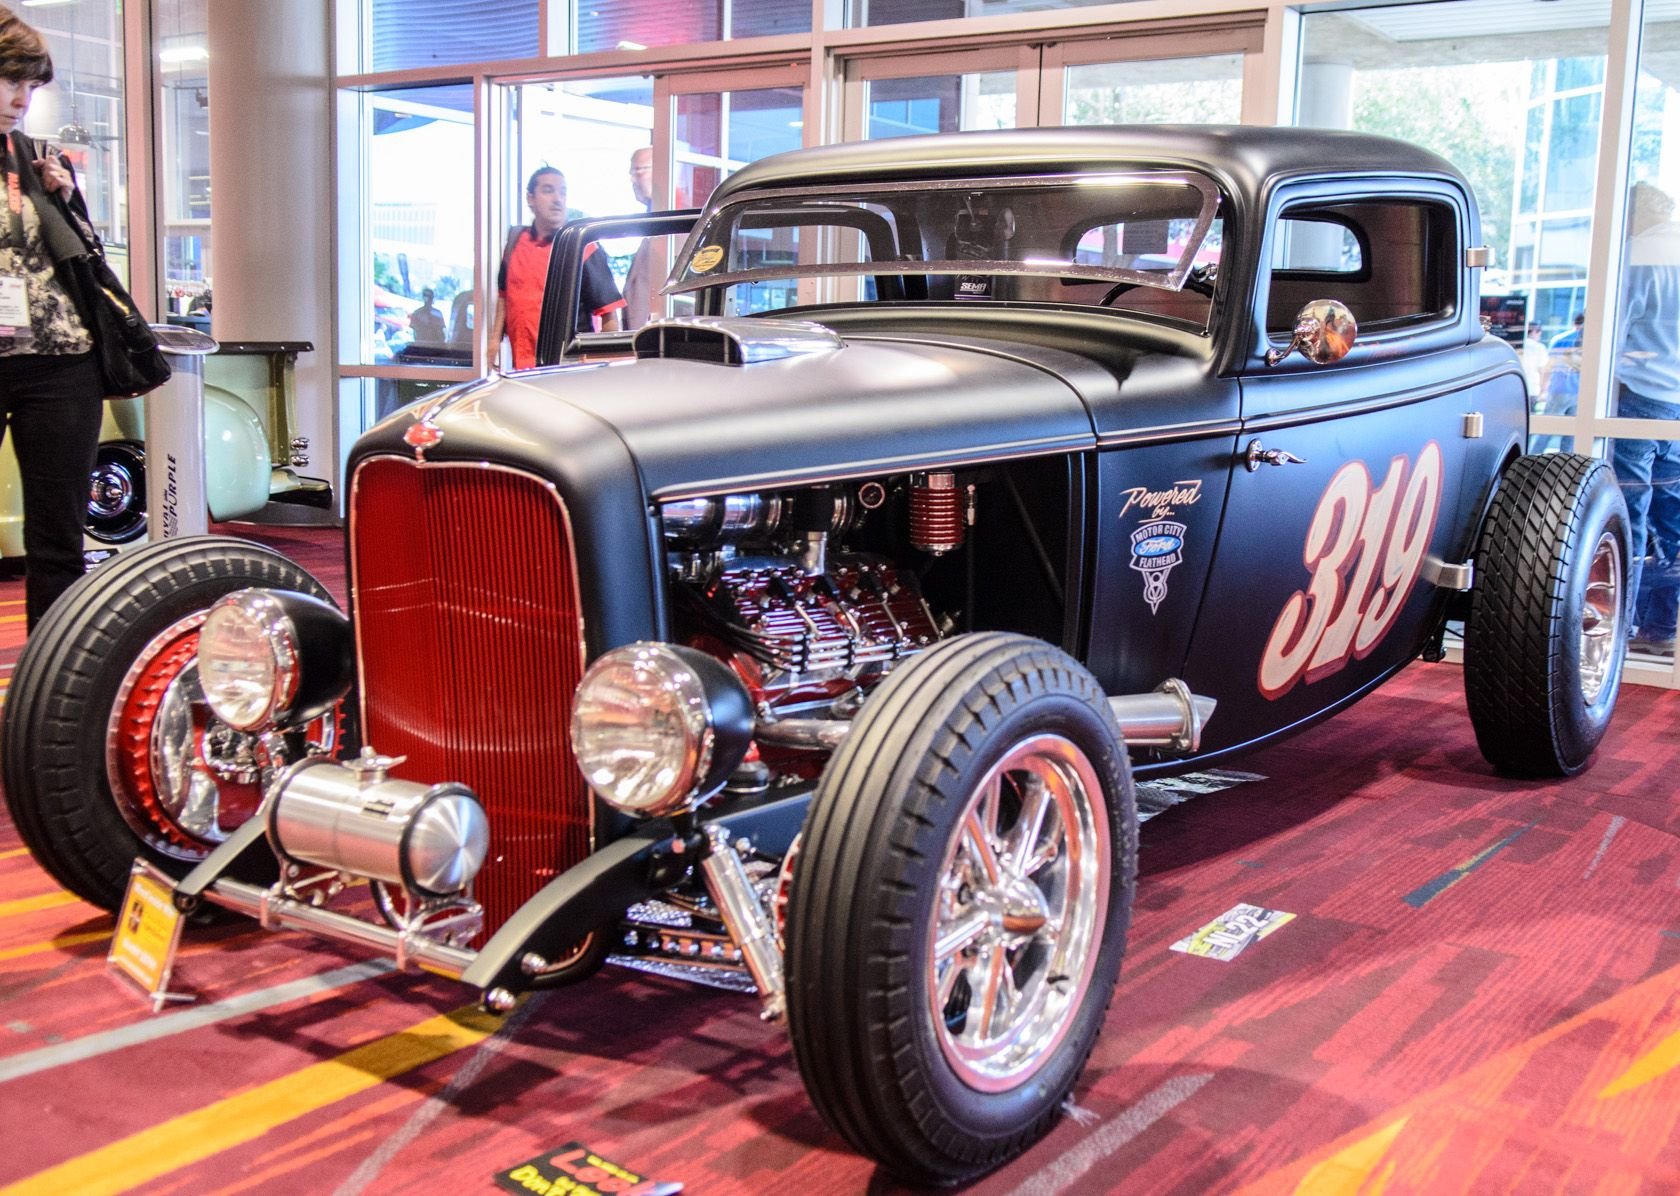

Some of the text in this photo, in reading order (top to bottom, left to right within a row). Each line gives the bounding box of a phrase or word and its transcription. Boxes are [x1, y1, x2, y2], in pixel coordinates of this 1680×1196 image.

[959, 282, 987, 291] SEMA
[167, 453, 178, 518] PURPLE
[1119, 480, 1202, 518] Powered
[1135, 525, 1183, 543] MOTOR CITY
[1139, 553, 1177, 568] FLATHEAD
[1258, 439, 1444, 701] 319
